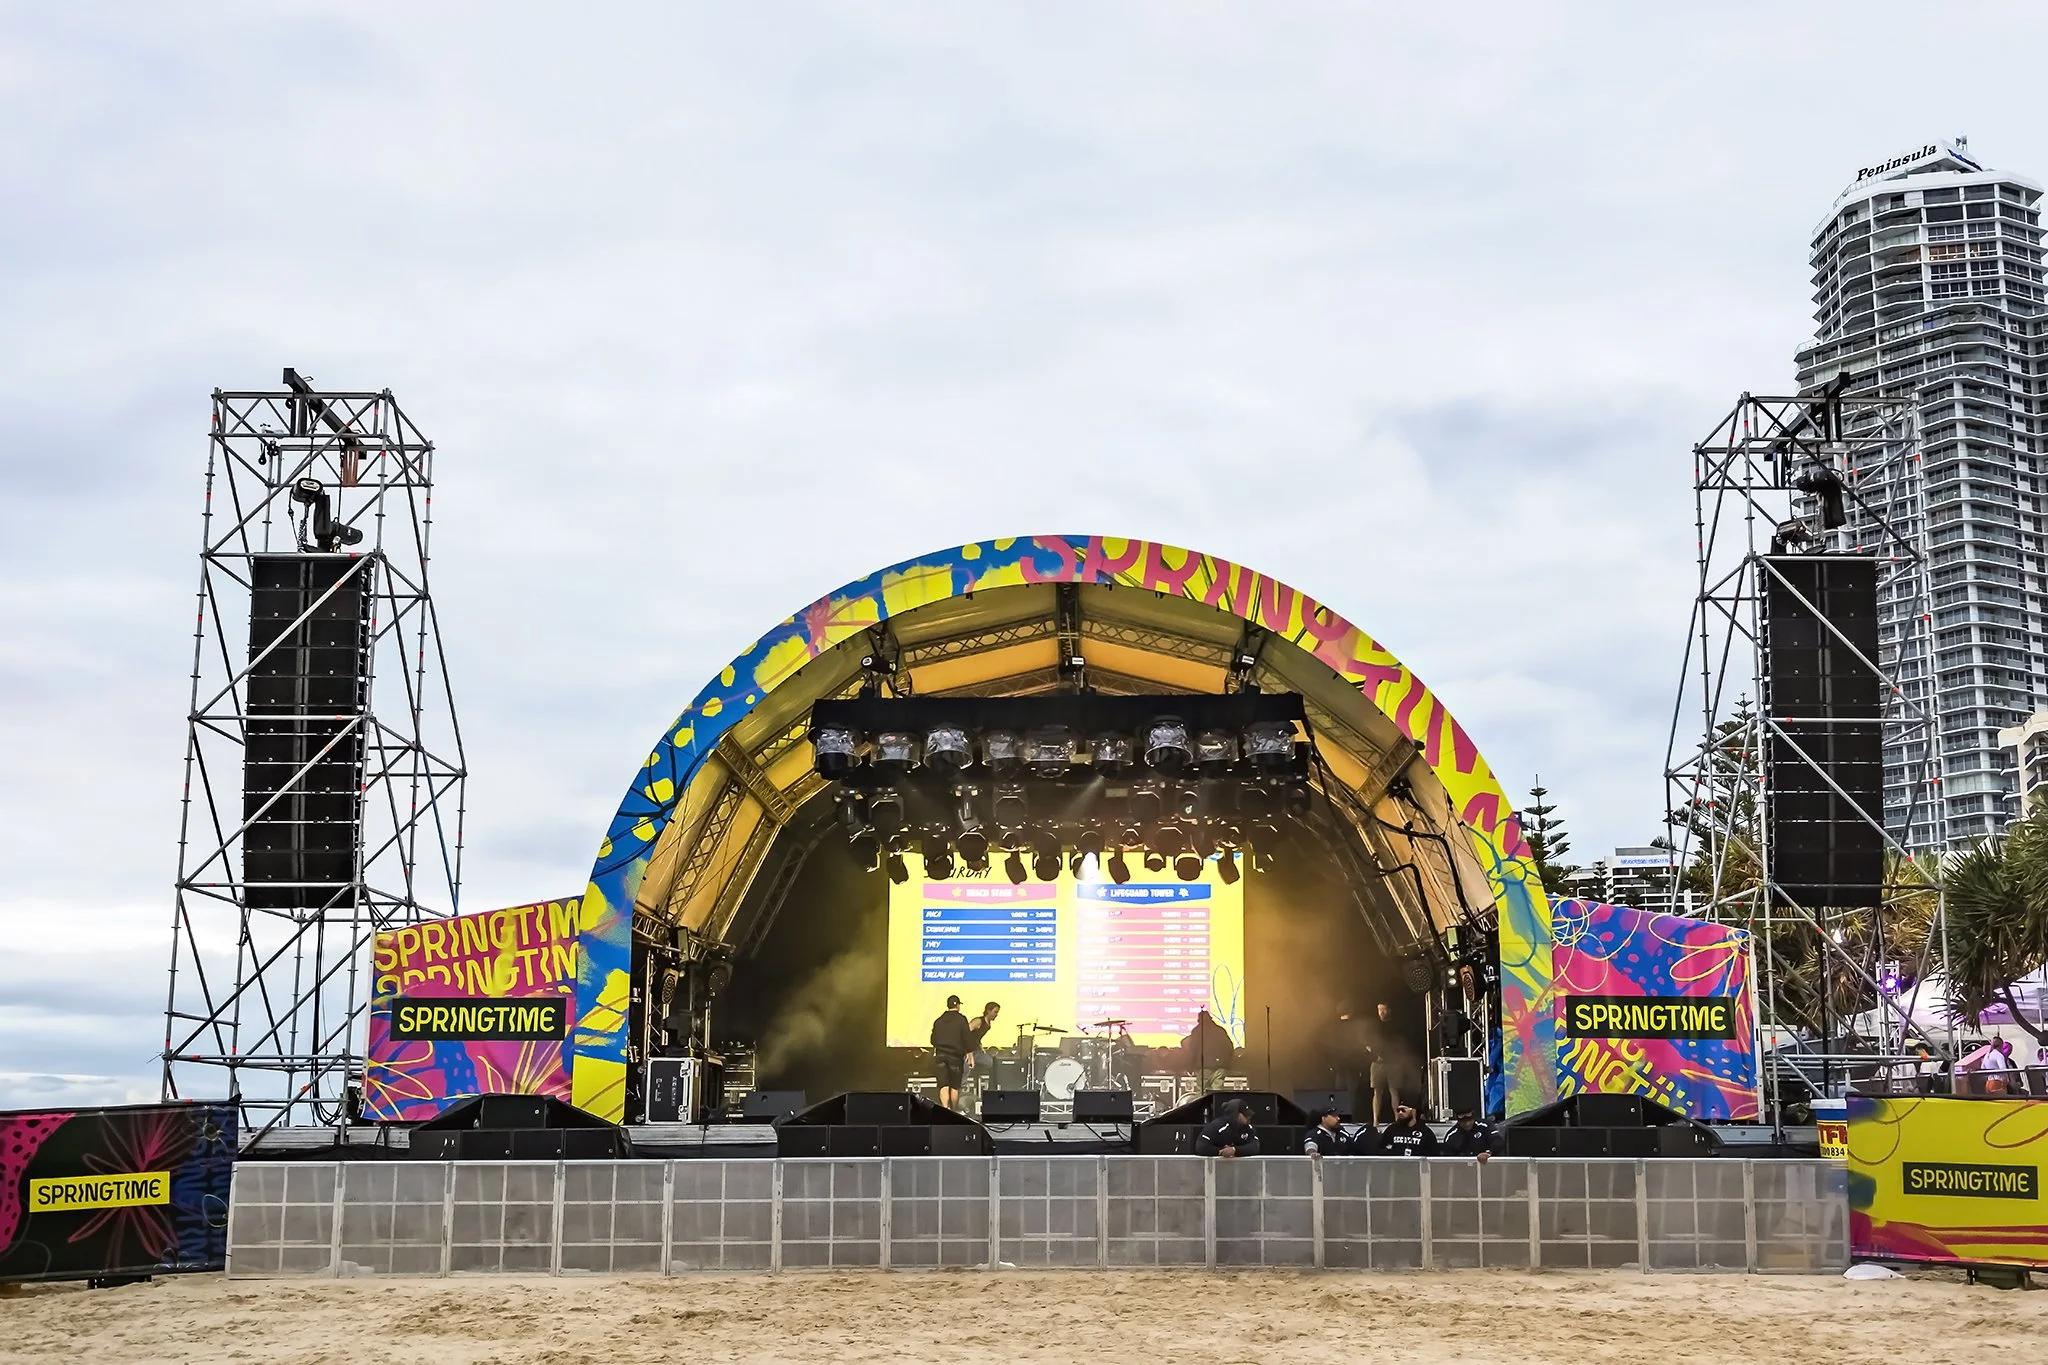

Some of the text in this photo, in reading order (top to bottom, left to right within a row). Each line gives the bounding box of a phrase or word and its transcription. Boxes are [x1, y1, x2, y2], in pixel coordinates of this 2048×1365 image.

[1856, 144, 1937, 182] Peninsula
[1110, 888, 1174, 897] LIFEGUARD TOWER
[399, 1006, 556, 1033] SPRINGTIME
[1575, 1004, 1727, 1031] SPRINGTIME
[38, 1178, 162, 1205] SPRINGTIME
[1910, 1168, 2029, 1193] SPRINGTIME
